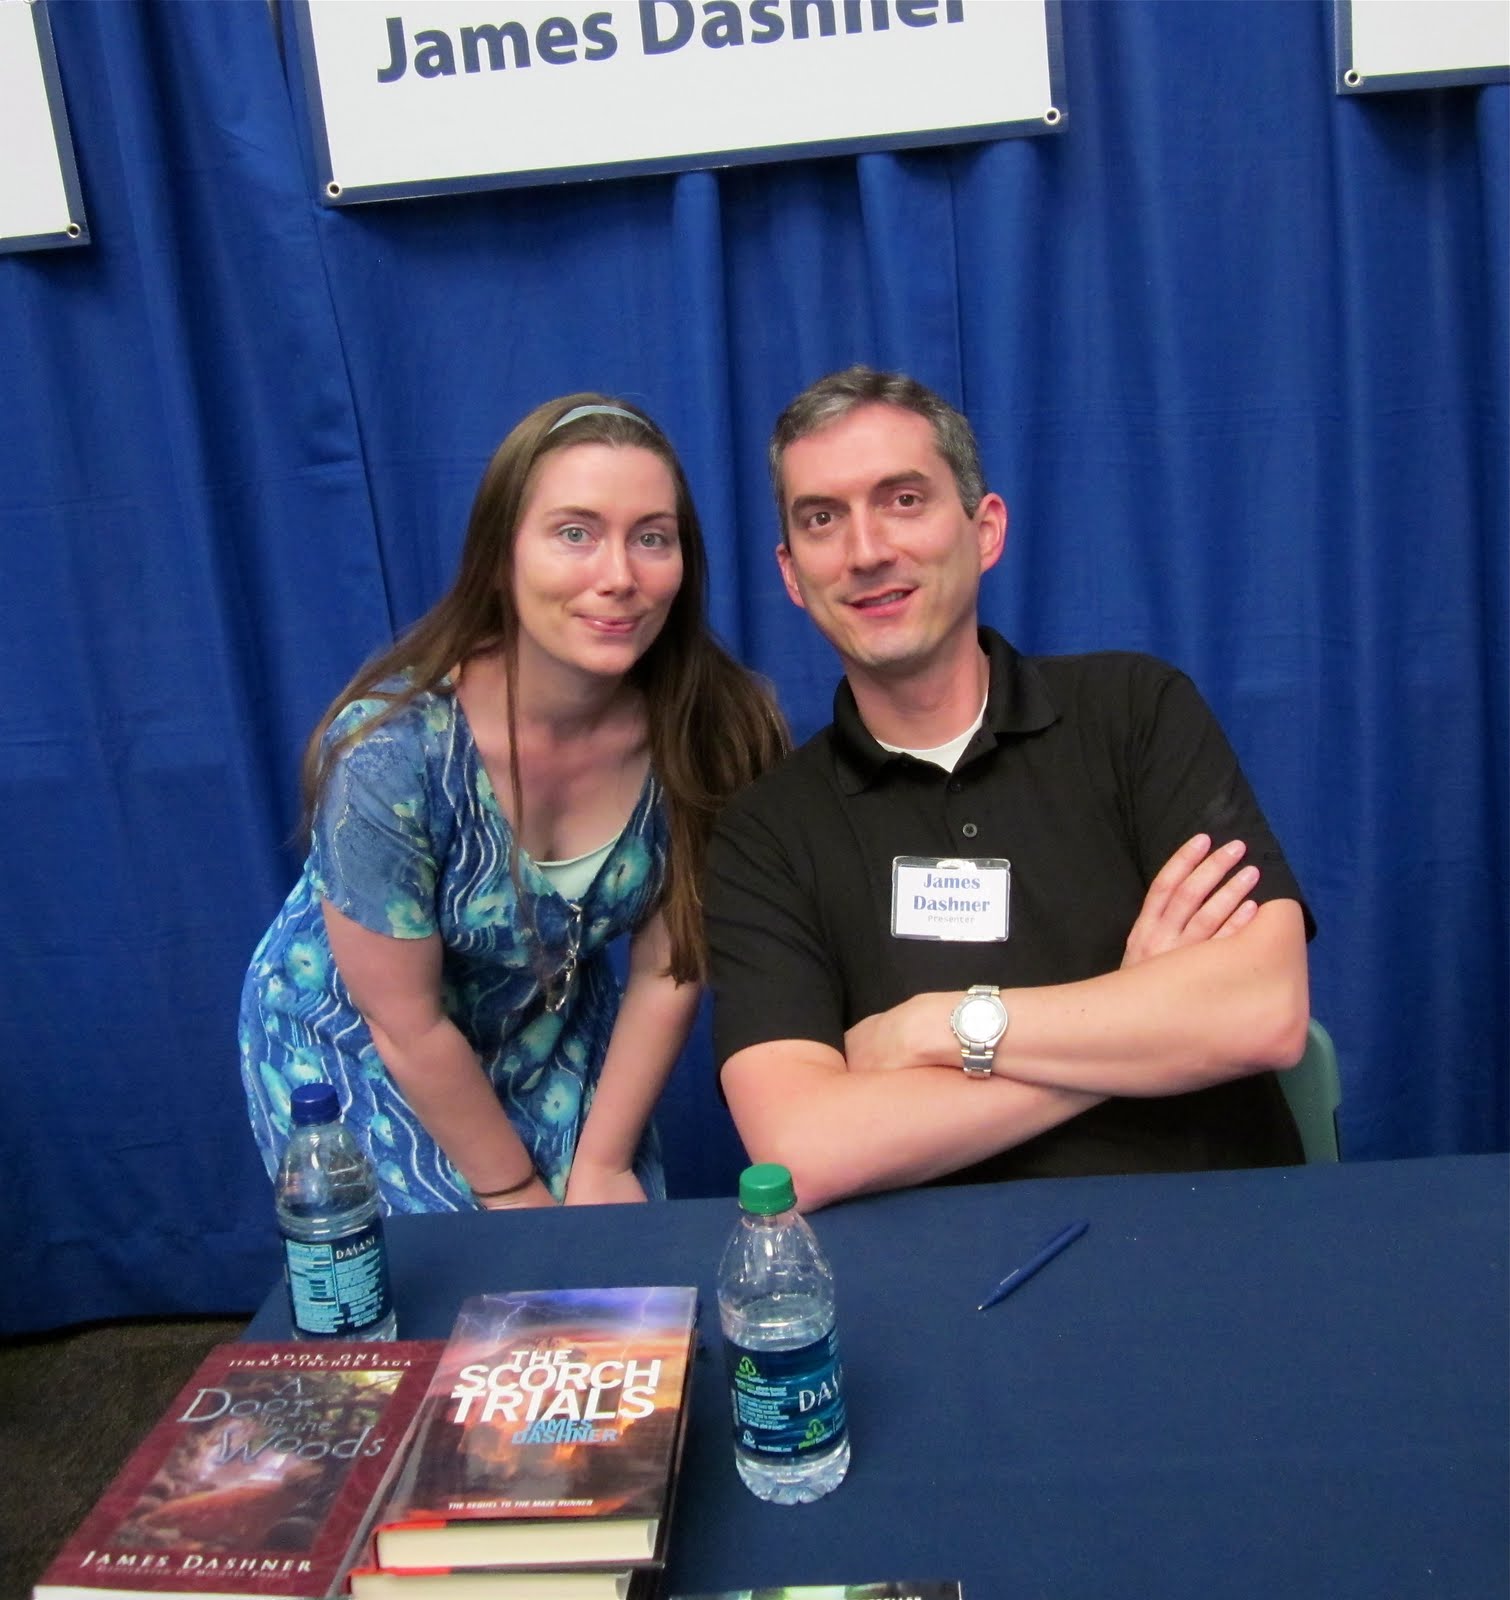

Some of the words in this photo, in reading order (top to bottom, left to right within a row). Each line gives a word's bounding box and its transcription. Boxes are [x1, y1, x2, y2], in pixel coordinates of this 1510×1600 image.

[377, 12, 618, 83] James
[924, 873, 981, 889] James
[913, 895, 990, 912] Dashner
[229, 1360, 281, 1368] JIMMY
[290, 1360, 361, 1368] FINCHER
[371, 1360, 412, 1368] SAGA
[271, 1353, 325, 1361] BOOK
[340, 1353, 381, 1361] ONE
[511, 1350, 573, 1367] THE
[454, 1359, 661, 1393] SCORCH
[272, 1376, 304, 1396] A
[176, 1387, 314, 1422] Door
[451, 1385, 656, 1424] TRIALS
[526, 1419, 594, 1432] JAMES
[212, 1420, 386, 1465] Woods
[511, 1428, 619, 1444] DASHNER
[448, 1502, 464, 1510] THE
[466, 1501, 497, 1510] SEQUEL
[557, 1499, 594, 1507] RUNNER
[79, 1550, 170, 1568] JAMES
[182, 1554, 312, 1573] DASHNER
